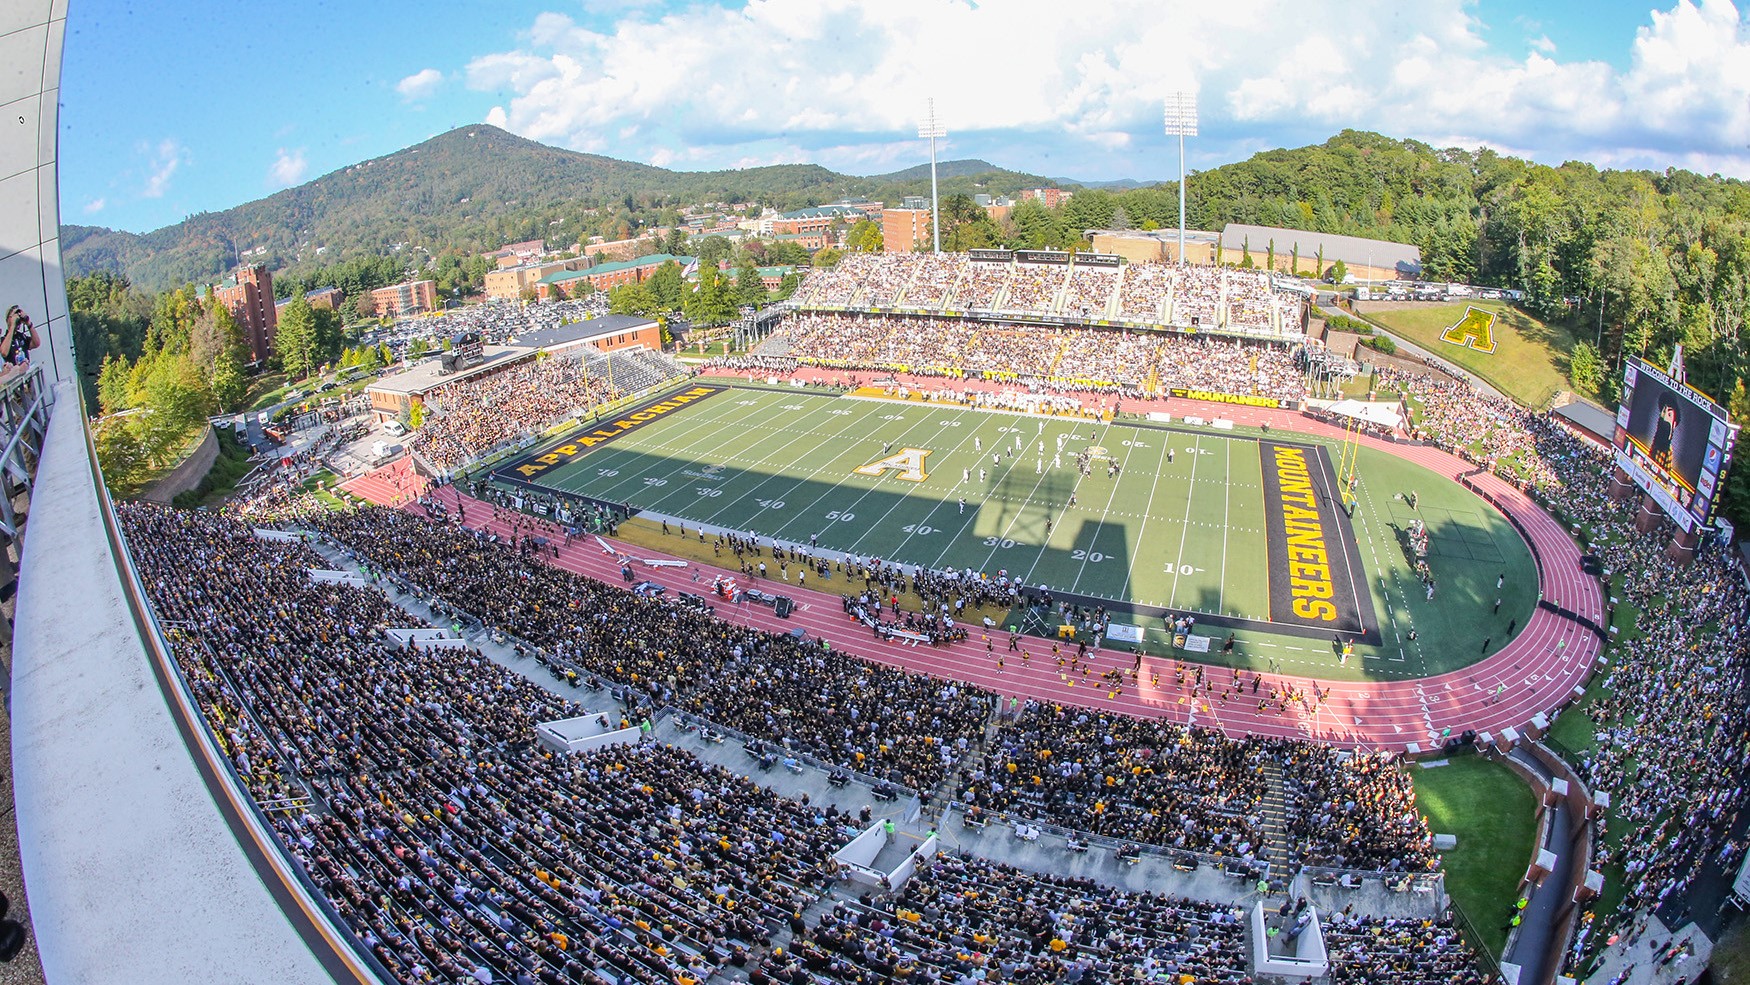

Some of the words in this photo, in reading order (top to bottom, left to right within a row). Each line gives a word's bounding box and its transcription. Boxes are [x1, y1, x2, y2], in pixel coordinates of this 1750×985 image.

[1440, 305, 1498, 354] A
[1640, 361, 1669, 384] WELCOME
[1669, 378, 1680, 389] TO
[1679, 383, 1693, 399] THE
[1692, 391, 1712, 410] ROCK
[1187, 389, 1279, 408] MOUNTAINEERS
[516, 386, 715, 477] APPALACHIAN
[1723, 429, 1736, 464] APP
[852, 447, 934, 483] A
[603, 469, 620, 478] 10
[650, 477, 668, 487] 20
[700, 487, 723, 498] 30
[1706, 470, 1727, 526] STATE
[761, 499, 786, 510] 40
[825, 511, 855, 522] 50
[902, 524, 933, 535] 40
[1274, 446, 1337, 621] MOUNTAINEERS
[984, 536, 1017, 549] 30
[1072, 549, 1104, 563] 20
[1163, 562, 1194, 576] 10
